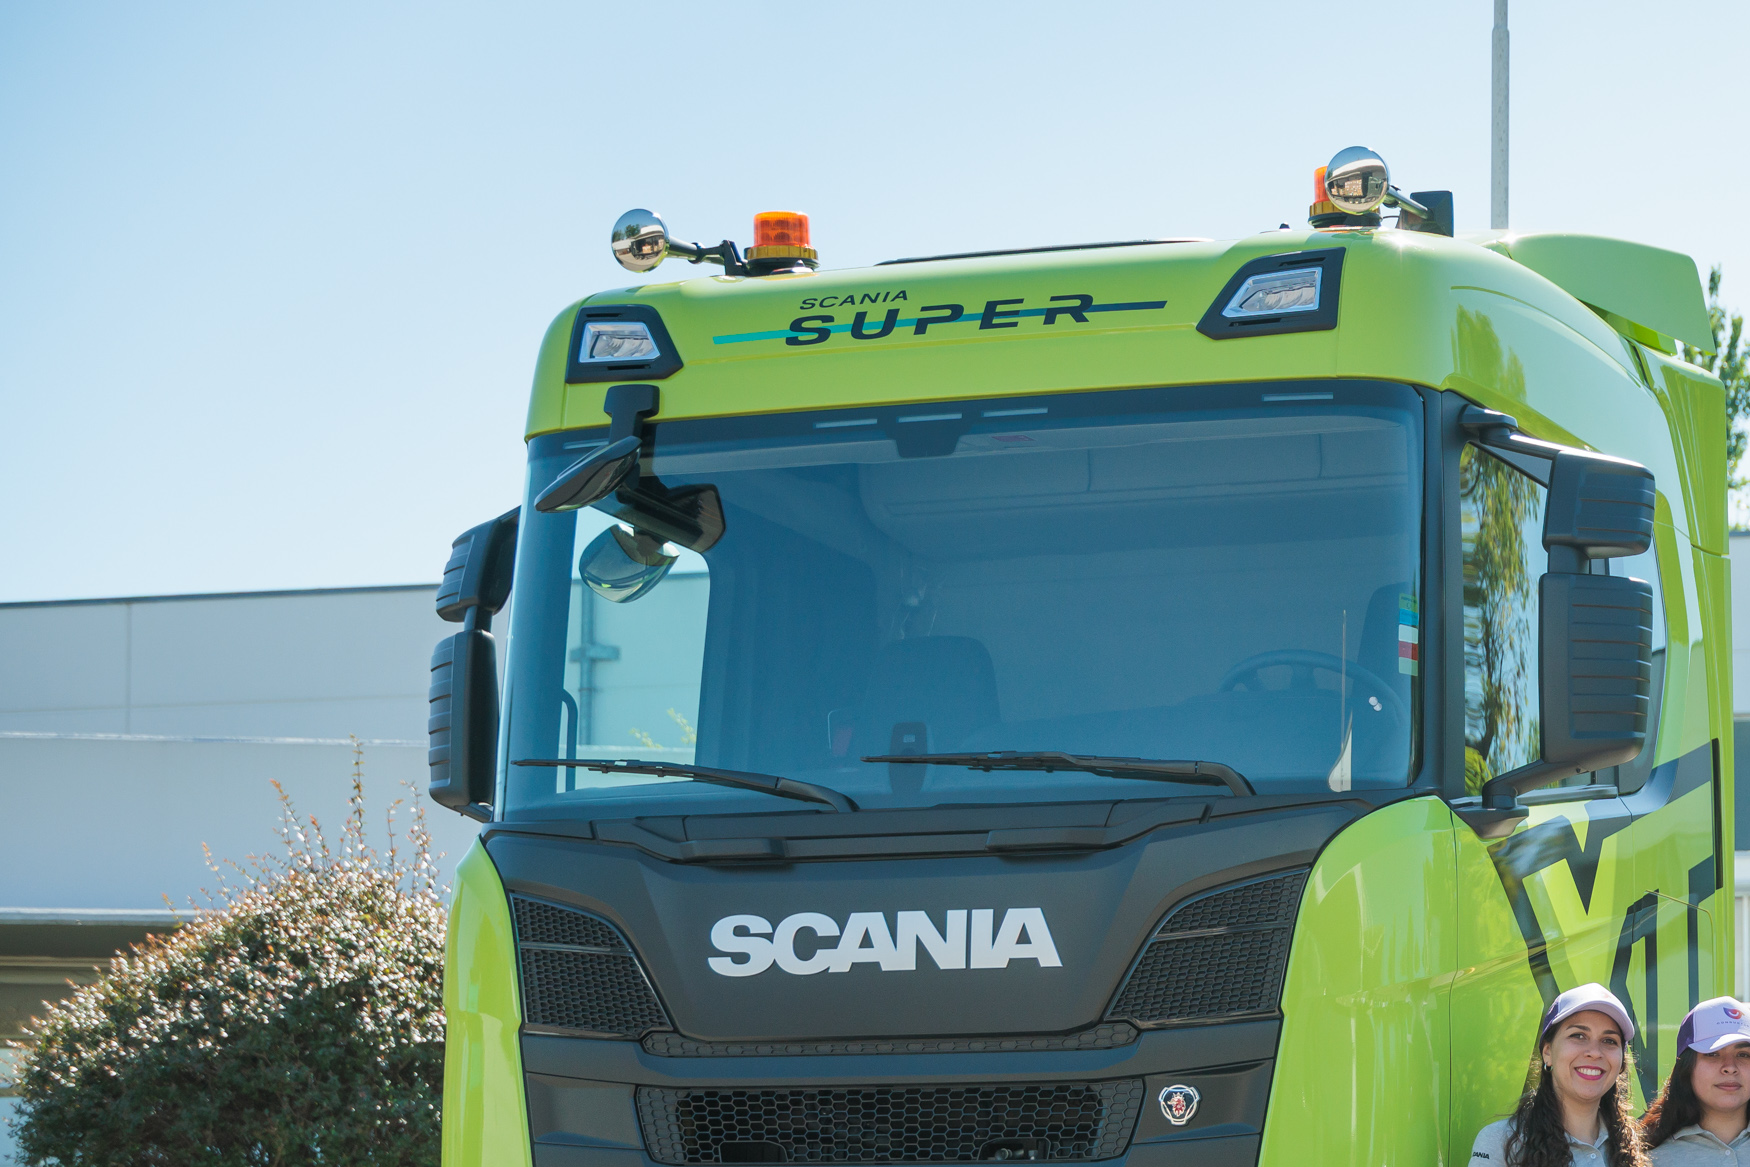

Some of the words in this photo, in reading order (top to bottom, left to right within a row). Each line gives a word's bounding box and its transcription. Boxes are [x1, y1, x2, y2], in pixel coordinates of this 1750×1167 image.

[785, 294, 1093, 346] SUPER
[799, 290, 908, 310] SCANIA
[707, 907, 1063, 977] SCANIA
